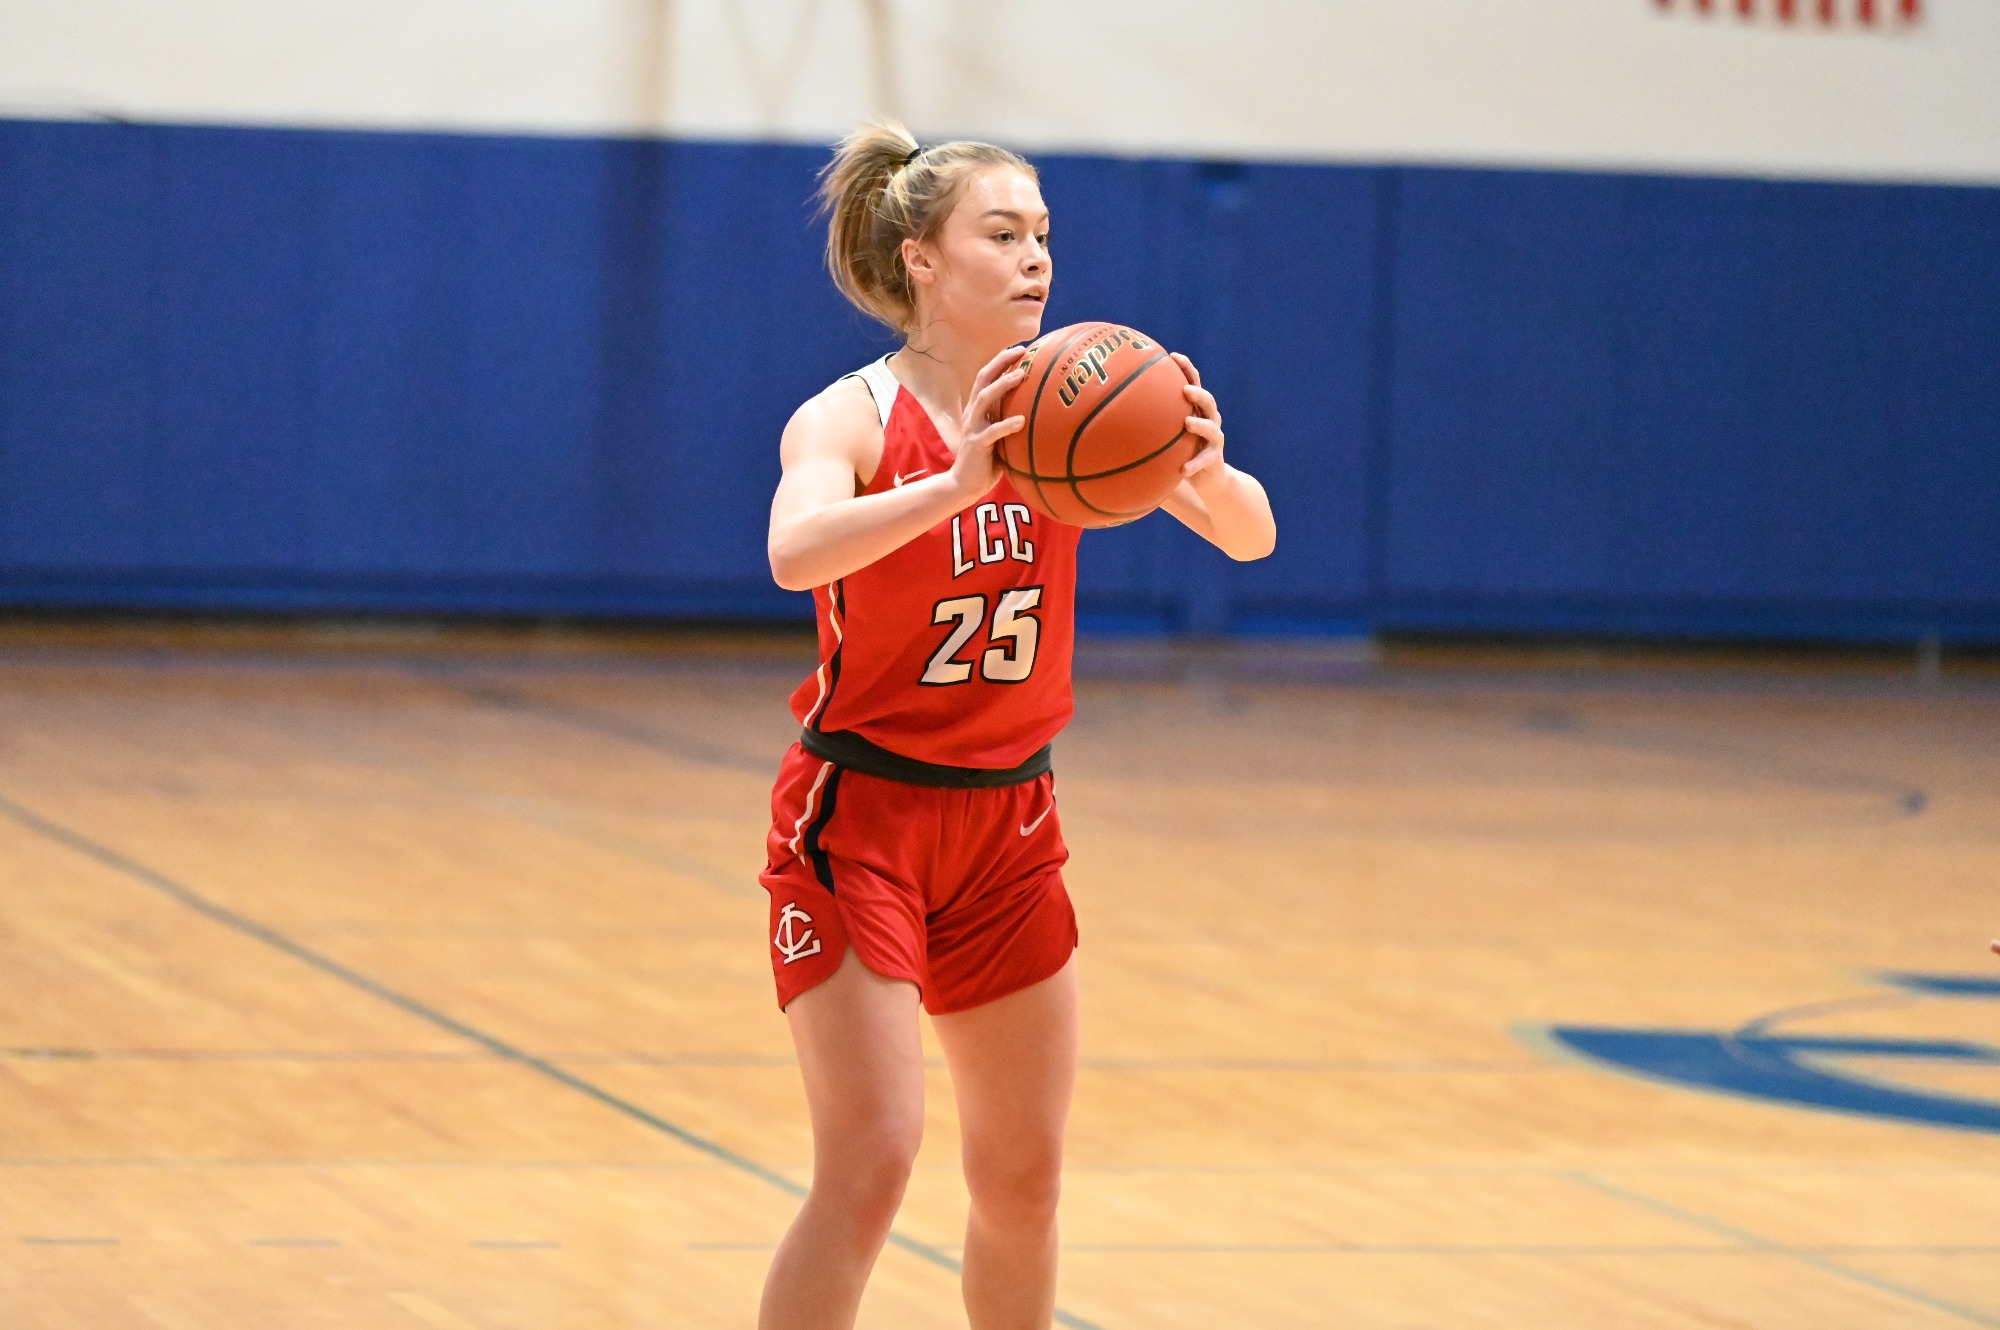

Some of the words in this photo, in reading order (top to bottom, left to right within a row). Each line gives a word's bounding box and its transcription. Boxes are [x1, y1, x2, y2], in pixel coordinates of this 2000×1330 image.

[1057, 328, 1152, 408] Baden
[951, 502, 1034, 579] LCC
[917, 584, 1044, 687] 25
